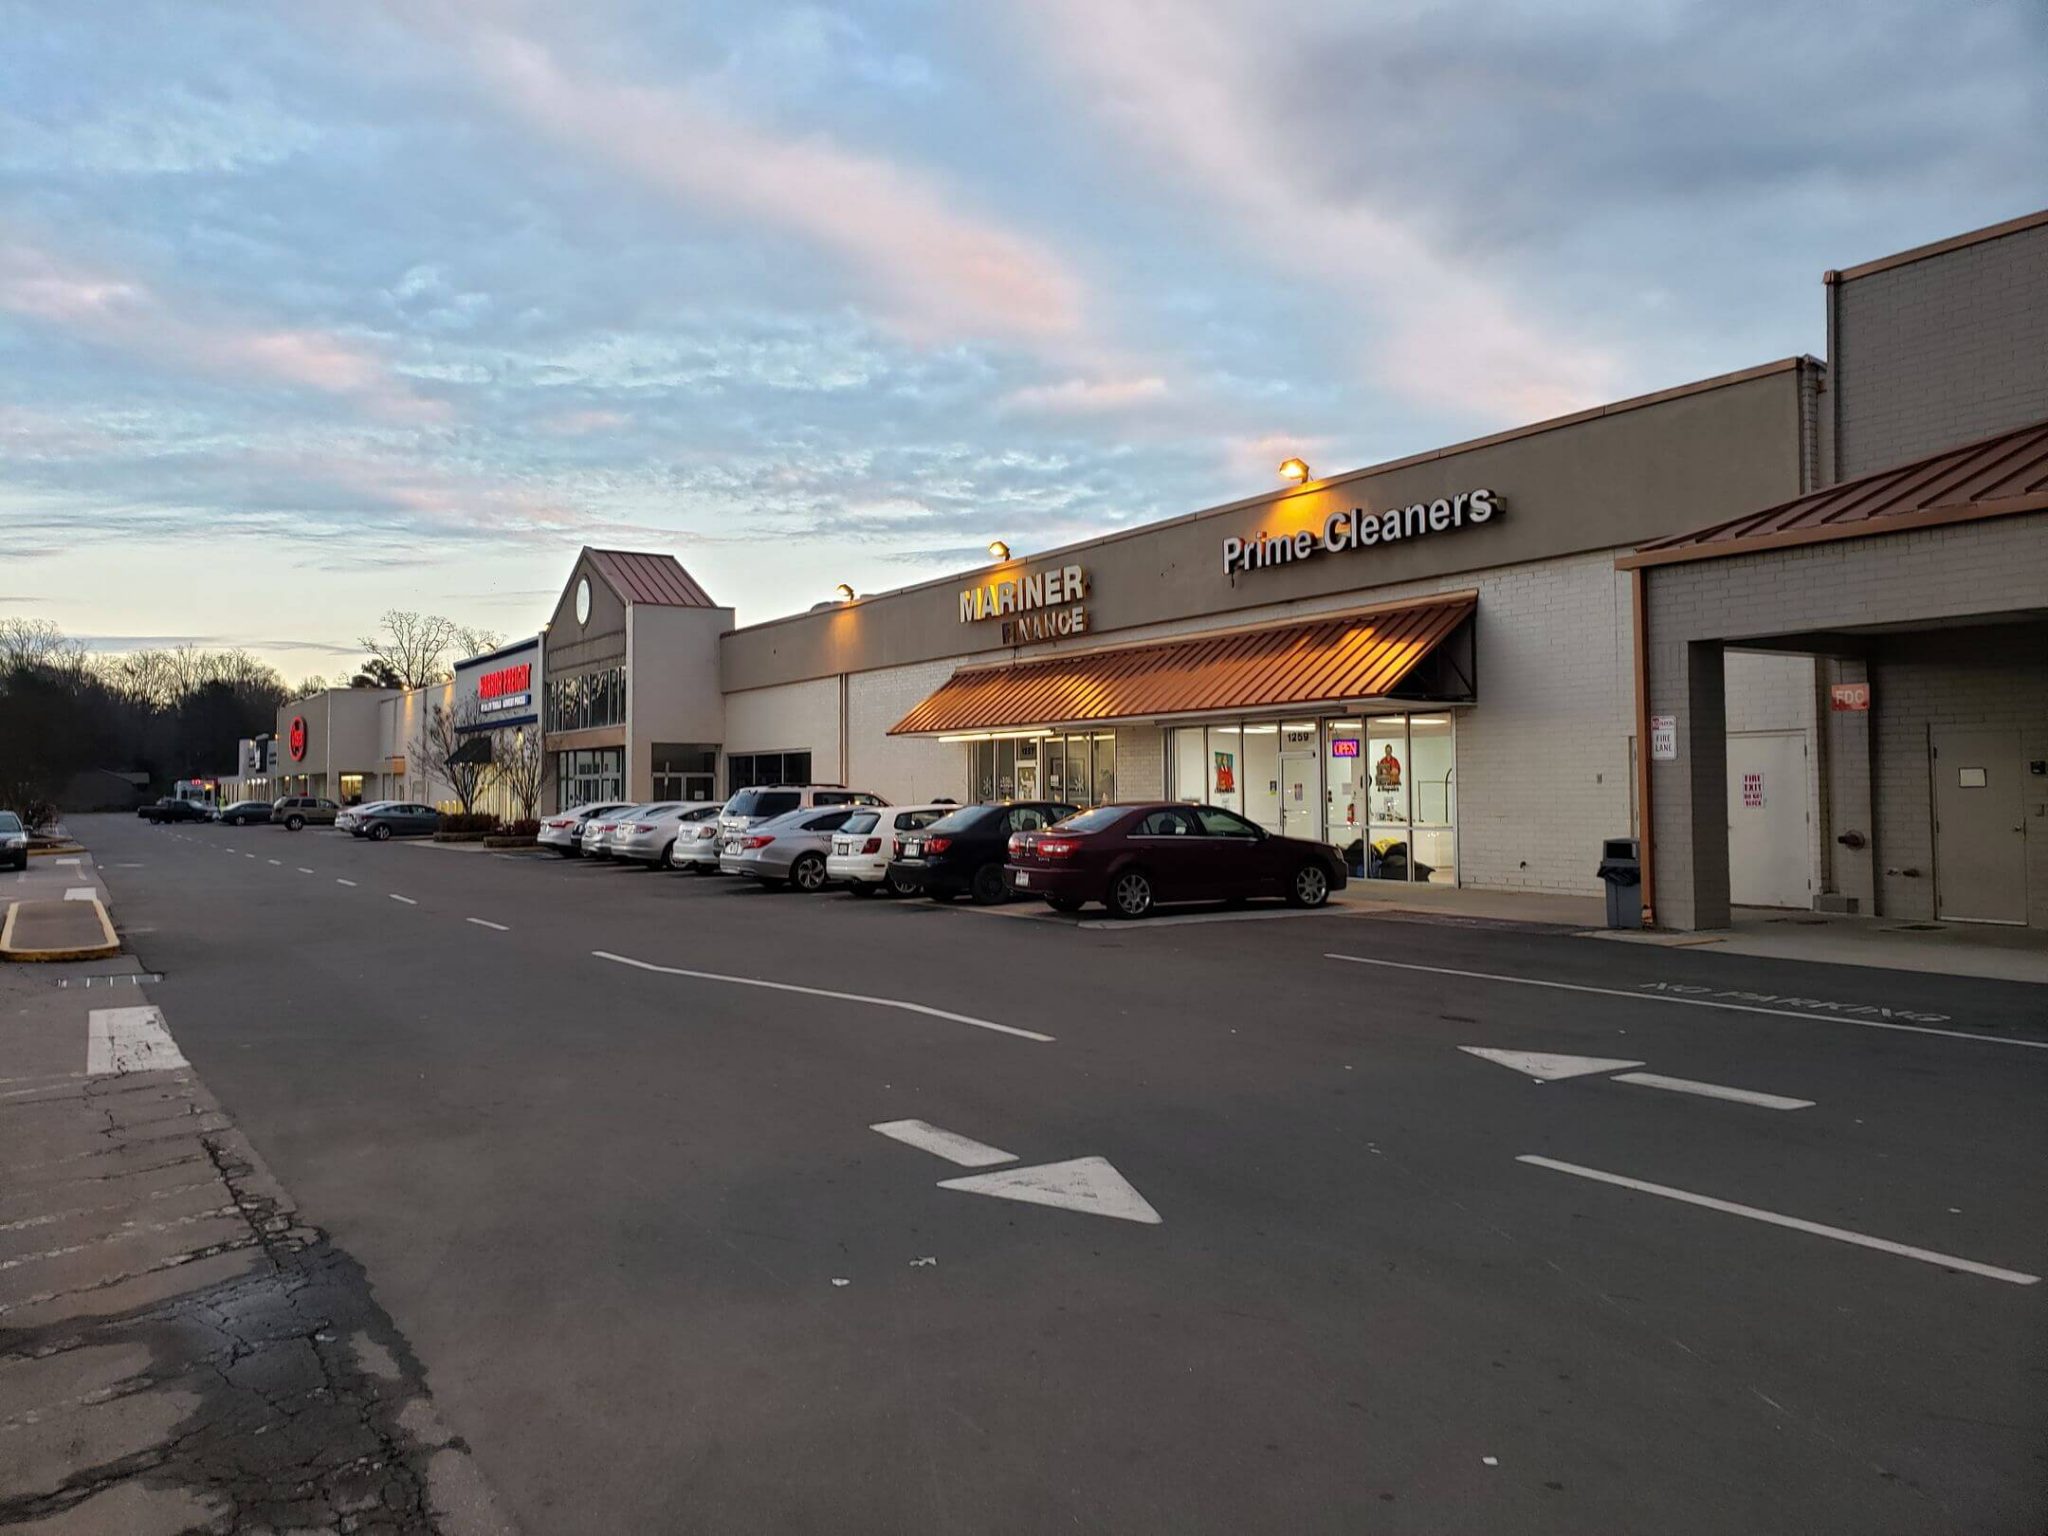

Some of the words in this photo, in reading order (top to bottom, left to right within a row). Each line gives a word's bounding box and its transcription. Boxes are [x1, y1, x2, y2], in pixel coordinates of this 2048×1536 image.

[1223, 530, 1314, 574] Prime
[1323, 489, 1495, 553] Cleaners
[959, 564, 1084, 623] MARINER
[1835, 689, 1864, 705] FDC
[1334, 740, 1357, 755] OPEN
[1744, 783, 1762, 791] EXIT
